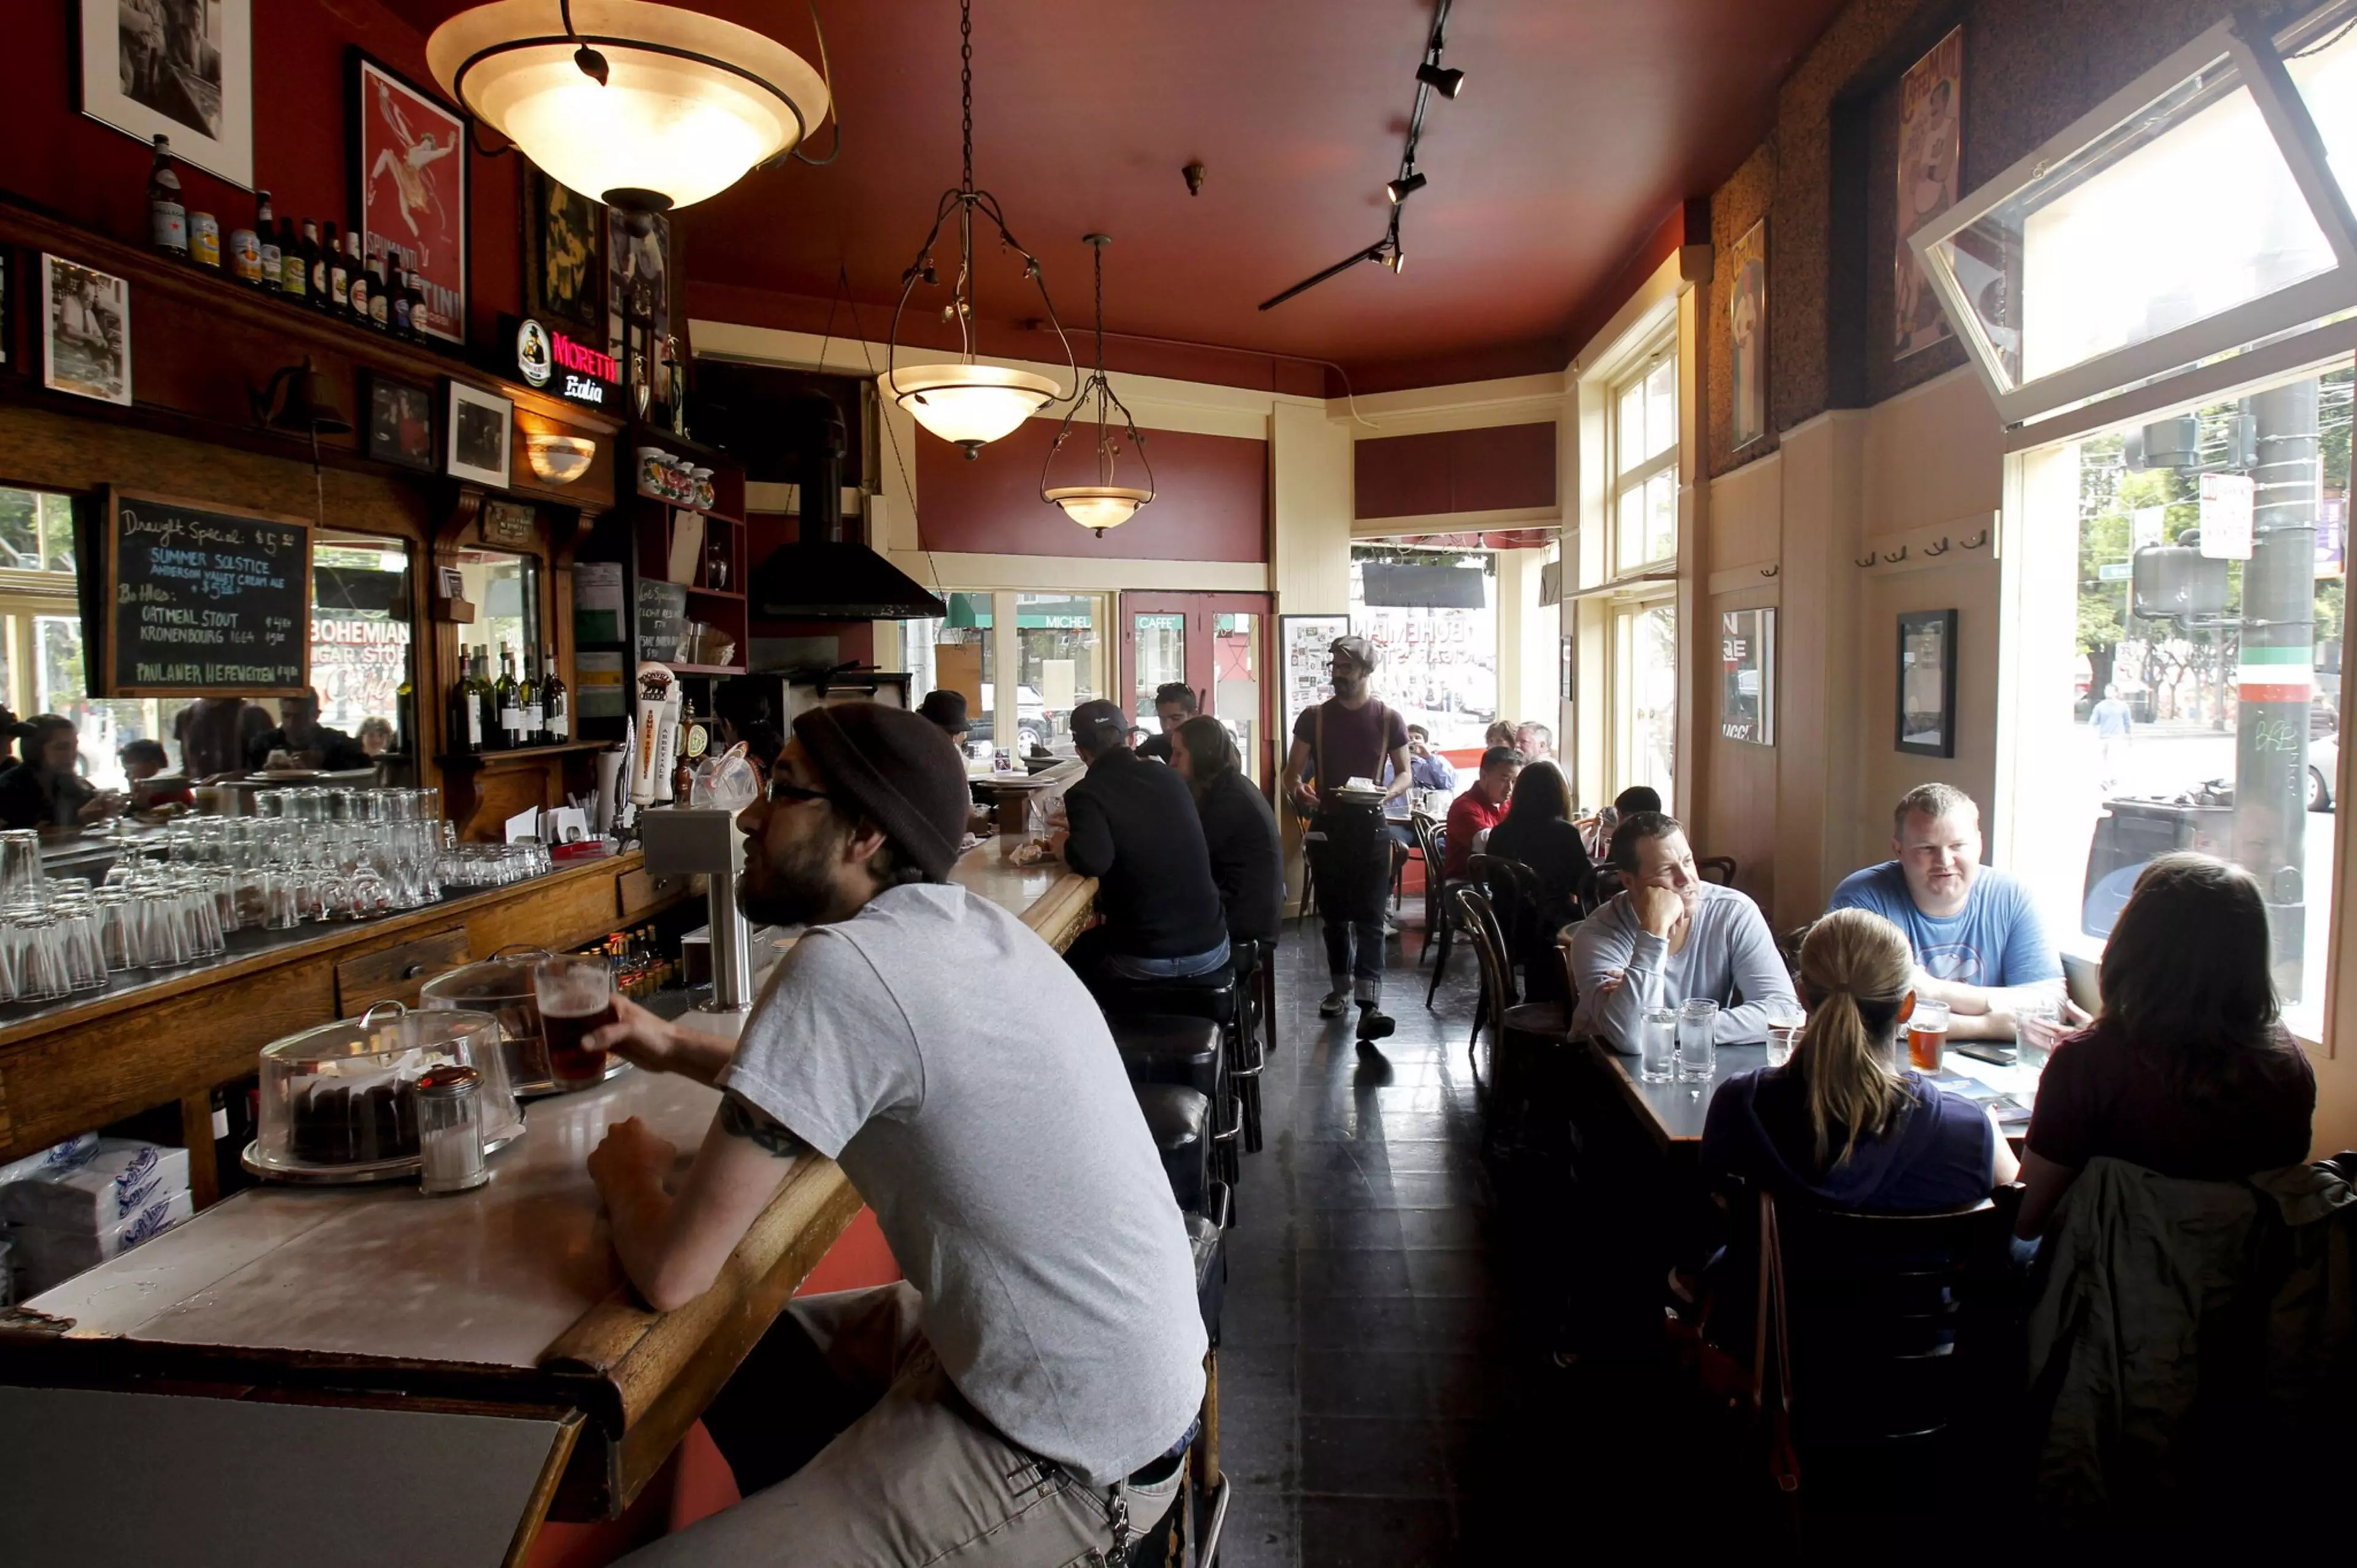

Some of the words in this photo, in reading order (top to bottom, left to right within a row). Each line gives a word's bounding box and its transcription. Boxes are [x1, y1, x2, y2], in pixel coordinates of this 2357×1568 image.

[552, 331, 617, 384] MORETTI
[564, 376, 602, 403] Italia
[150, 548, 206, 566] SUMMER
[215, 554, 269, 574] SOLSTICE
[150, 565, 202, 580] ANDERSON
[204, 571, 235, 585] VALLEY
[270, 578, 285, 589] ALE
[142, 605, 198, 625] OATMEAL
[201, 610, 239, 628] STOUT
[1045, 616, 1091, 628] MICHEL
[140, 626, 224, 644] KRONENBOURG
[230, 631, 255, 643] 1664
[311, 619, 411, 644] BOHEMIAN
[136, 663, 203, 684] PAULANER
